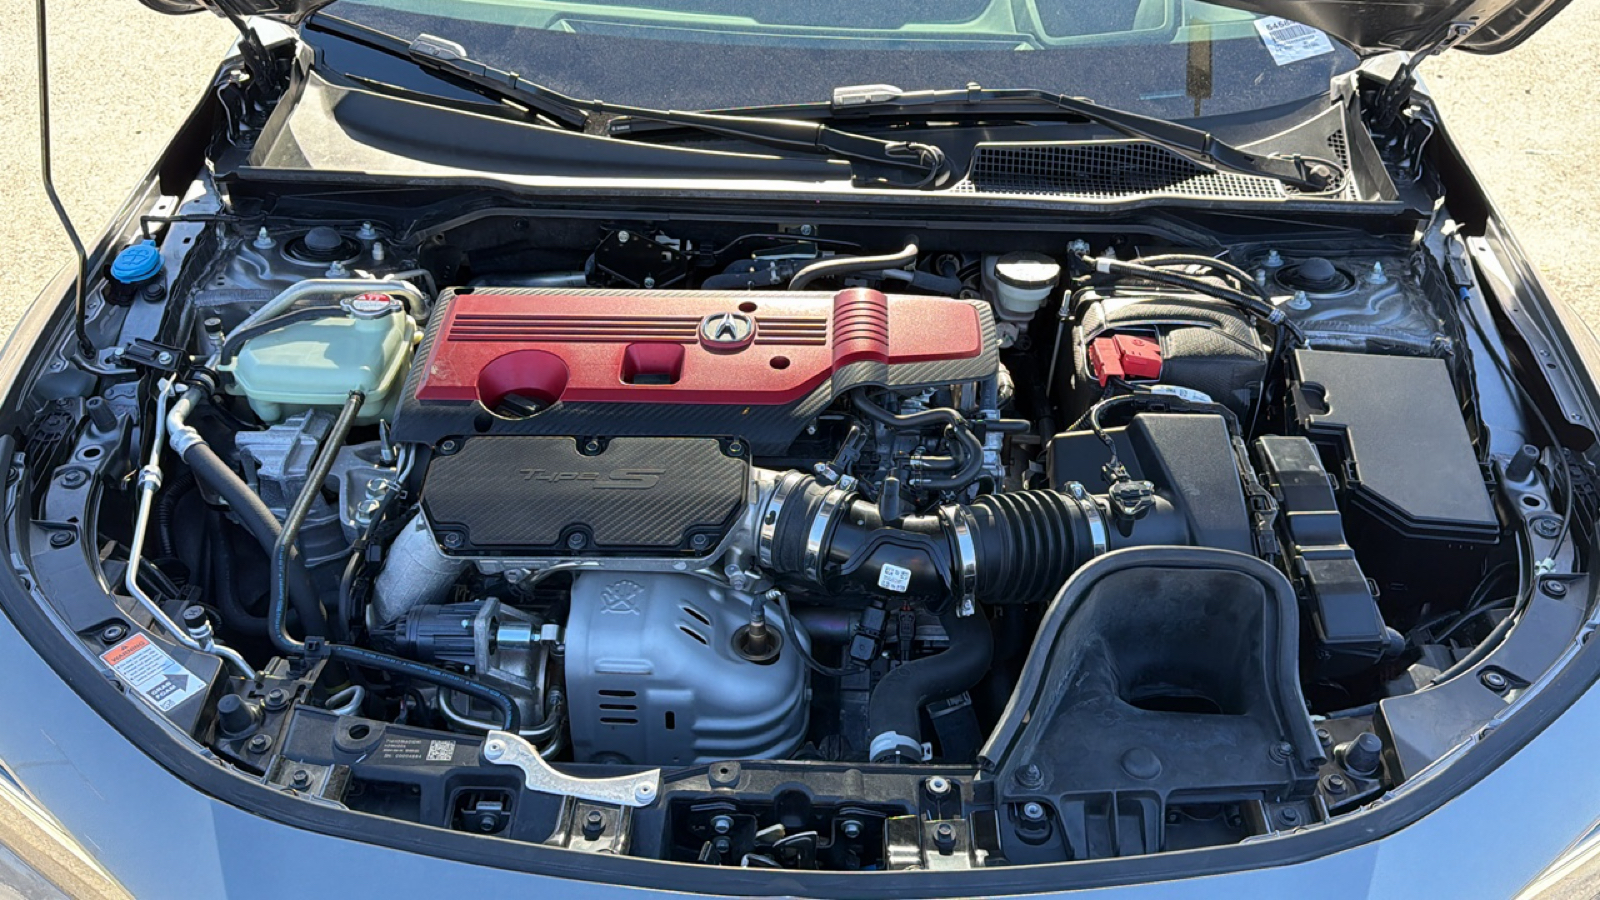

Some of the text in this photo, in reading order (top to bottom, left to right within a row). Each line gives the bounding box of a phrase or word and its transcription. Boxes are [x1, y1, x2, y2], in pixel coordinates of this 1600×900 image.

[520, 468, 667, 490] Type S
[110, 641, 146, 662] WARNING
